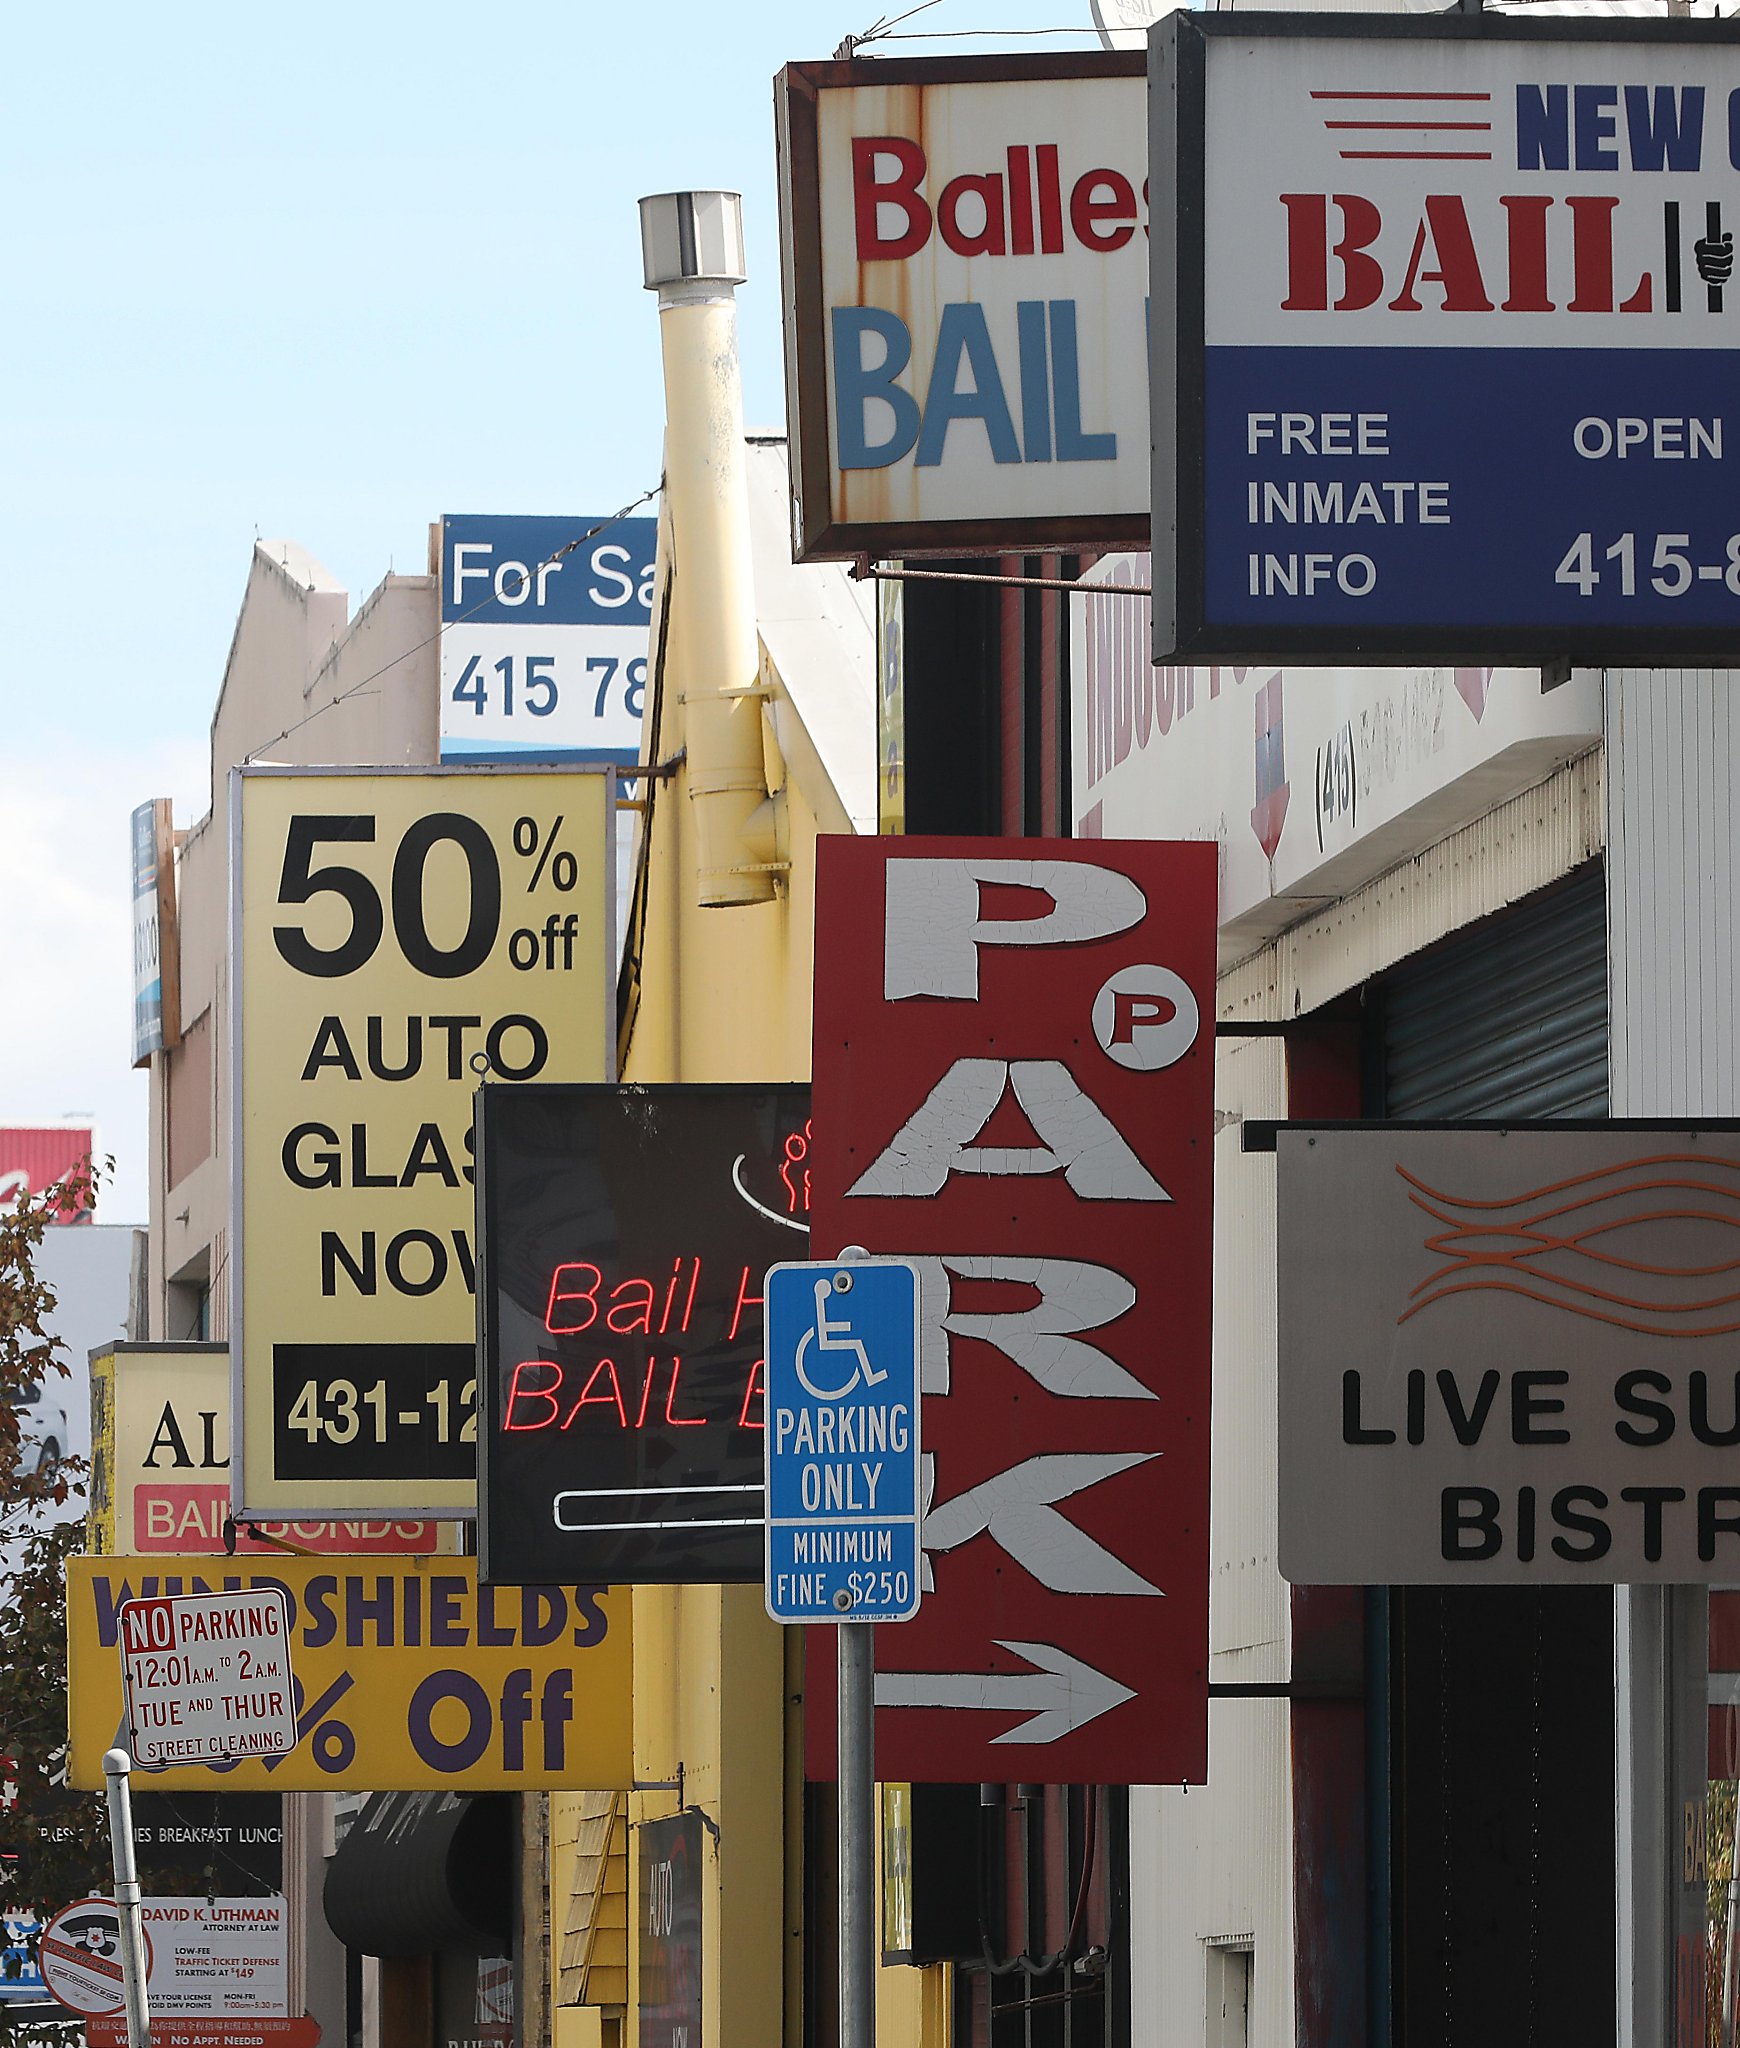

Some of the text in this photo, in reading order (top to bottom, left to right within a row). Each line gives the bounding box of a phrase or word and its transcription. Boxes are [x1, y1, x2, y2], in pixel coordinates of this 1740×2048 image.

[1515, 83, 1706, 173] NEW
[851, 136, 1149, 261] Balle
[1278, 193, 1654, 314] BAIL
[831, 299, 1118, 470] BAIL
[1246, 412, 1391, 456] FREE
[1572, 416, 1724, 460] OPEN
[1246, 481, 1452, 525] INMATE
[452, 542, 565, 608] For
[1247, 552, 1378, 597] INFO
[452, 655, 559, 717] 415
[508, 913, 579, 971] off
[300, 1013, 549, 1081] AUTO
[281, 1121, 476, 1189] GLA
[320, 1228, 476, 1297] NO
[544, 1256, 701, 1335] Bail
[503, 1355, 708, 1431] BAIL
[1342, 1369, 1740, 1447] LIVE SU
[776, 1403, 909, 1456] PARKING
[801, 1462, 884, 1513] ONLY
[793, 1529, 892, 1565] MINIMUM
[1441, 1485, 1740, 1563] BISTR
[91, 1574, 610, 1649] WSHIELDS
[777, 1569, 909, 1609] FINE $250
[128, 1605, 279, 1650] NO PARKING
[219, 1656, 231, 1668] TO
[138, 1692, 284, 1728] TUE AND THUR
[408, 1668, 574, 1773] Off
[147, 1738, 203, 1758] STREET
[209, 1731, 284, 1753] CLEANING
[159, 1827, 232, 1843] BREAKFAST
[141, 1908, 280, 1922] DAVID K. UTHMAN
[648, 1858, 673, 1937] AUTO
[174, 1947, 211, 1955] LOW-FEE
[202, 1924, 280, 1932] ATTORNEY AT LAW
[174, 1957, 280, 1966] TRAFFIC TICKET DEFENSE
[174, 1967, 255, 1979] STARTING AT $149
[161, 1993, 182, 2001] YOUR
[183, 1993, 212, 2001] LICENSE
[223, 1992, 256, 2001] MON-FRI
[171, 2035, 190, 2045] NO
[192, 2035, 221, 2045] APPT.
[224, 2035, 264, 2045] NEEDED
